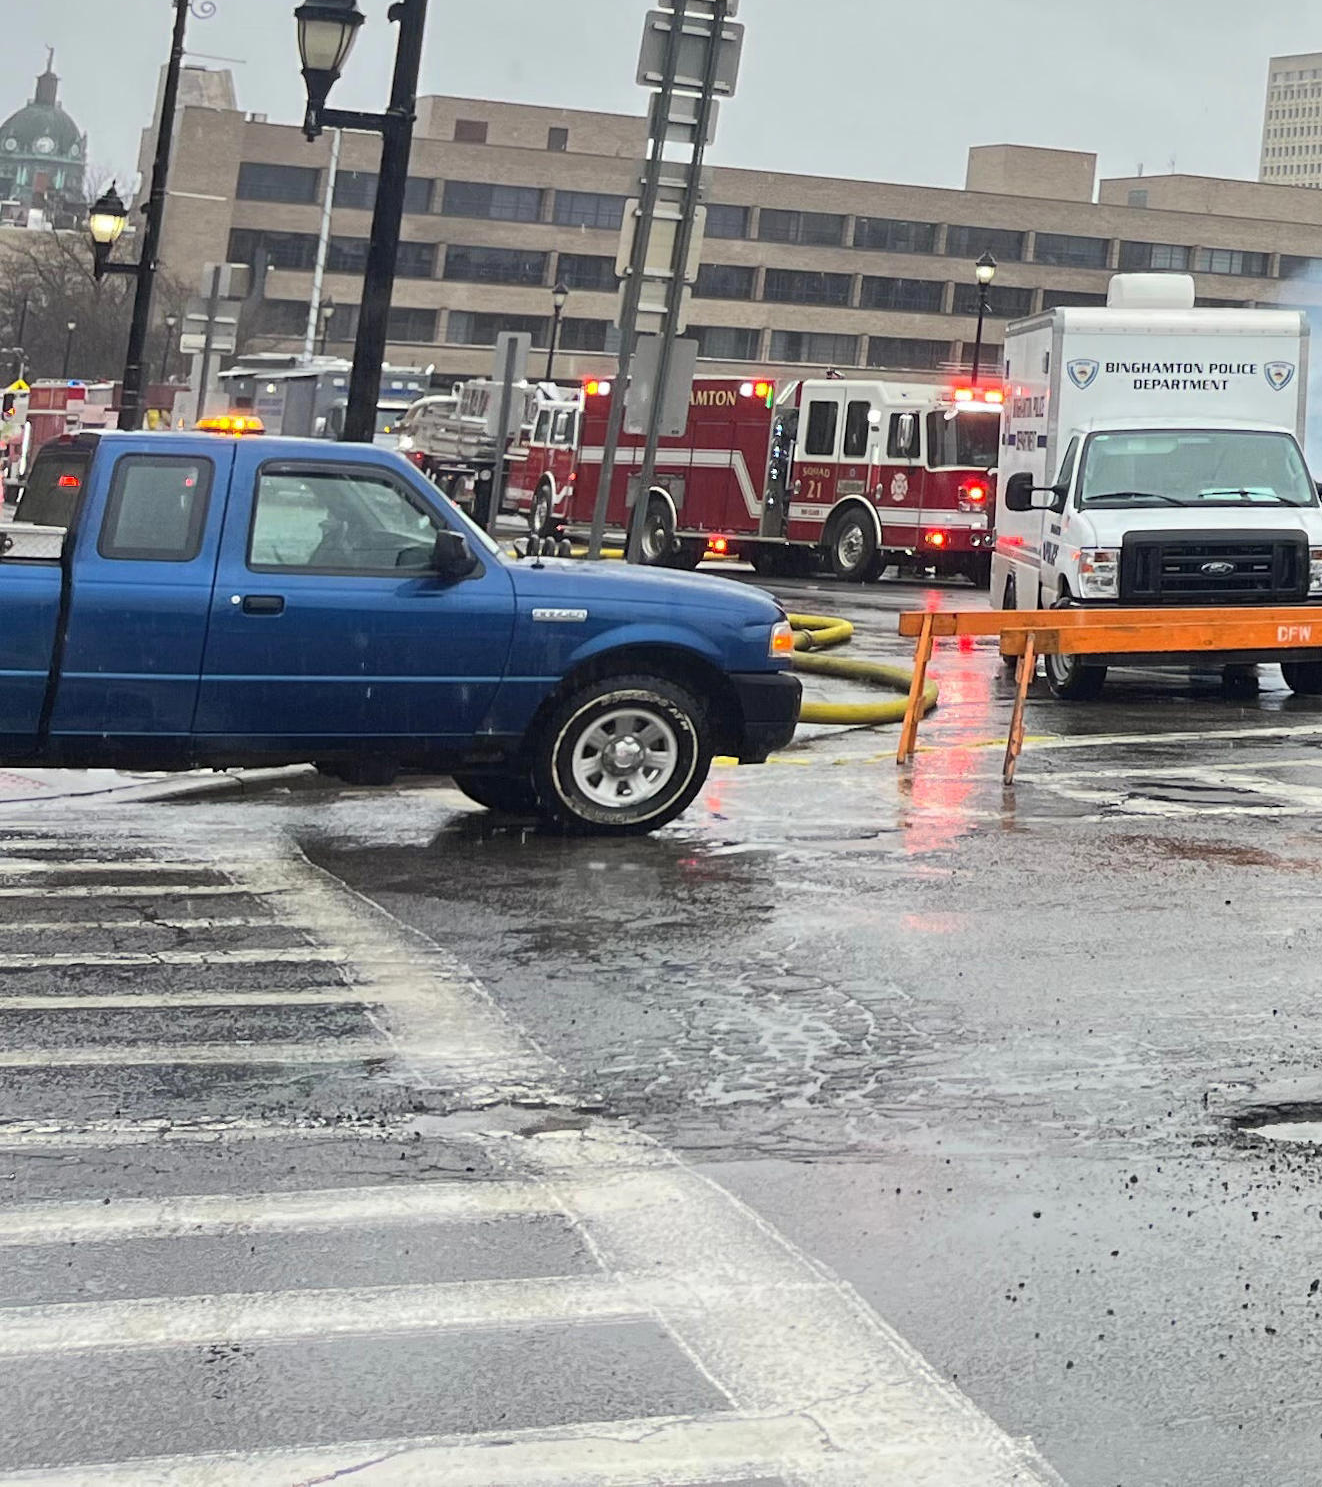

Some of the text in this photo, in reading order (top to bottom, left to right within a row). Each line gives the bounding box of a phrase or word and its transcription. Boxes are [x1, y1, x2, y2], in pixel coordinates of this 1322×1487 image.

[1104, 362, 1204, 375] BINGHAMTON
[1208, 362, 1258, 375] POLICE
[1133, 378, 1229, 391] DEPARTMENT
[689, 390, 737, 406] AMTON
[802, 466, 831, 479] SQUAD
[806, 479, 822, 499] 21
